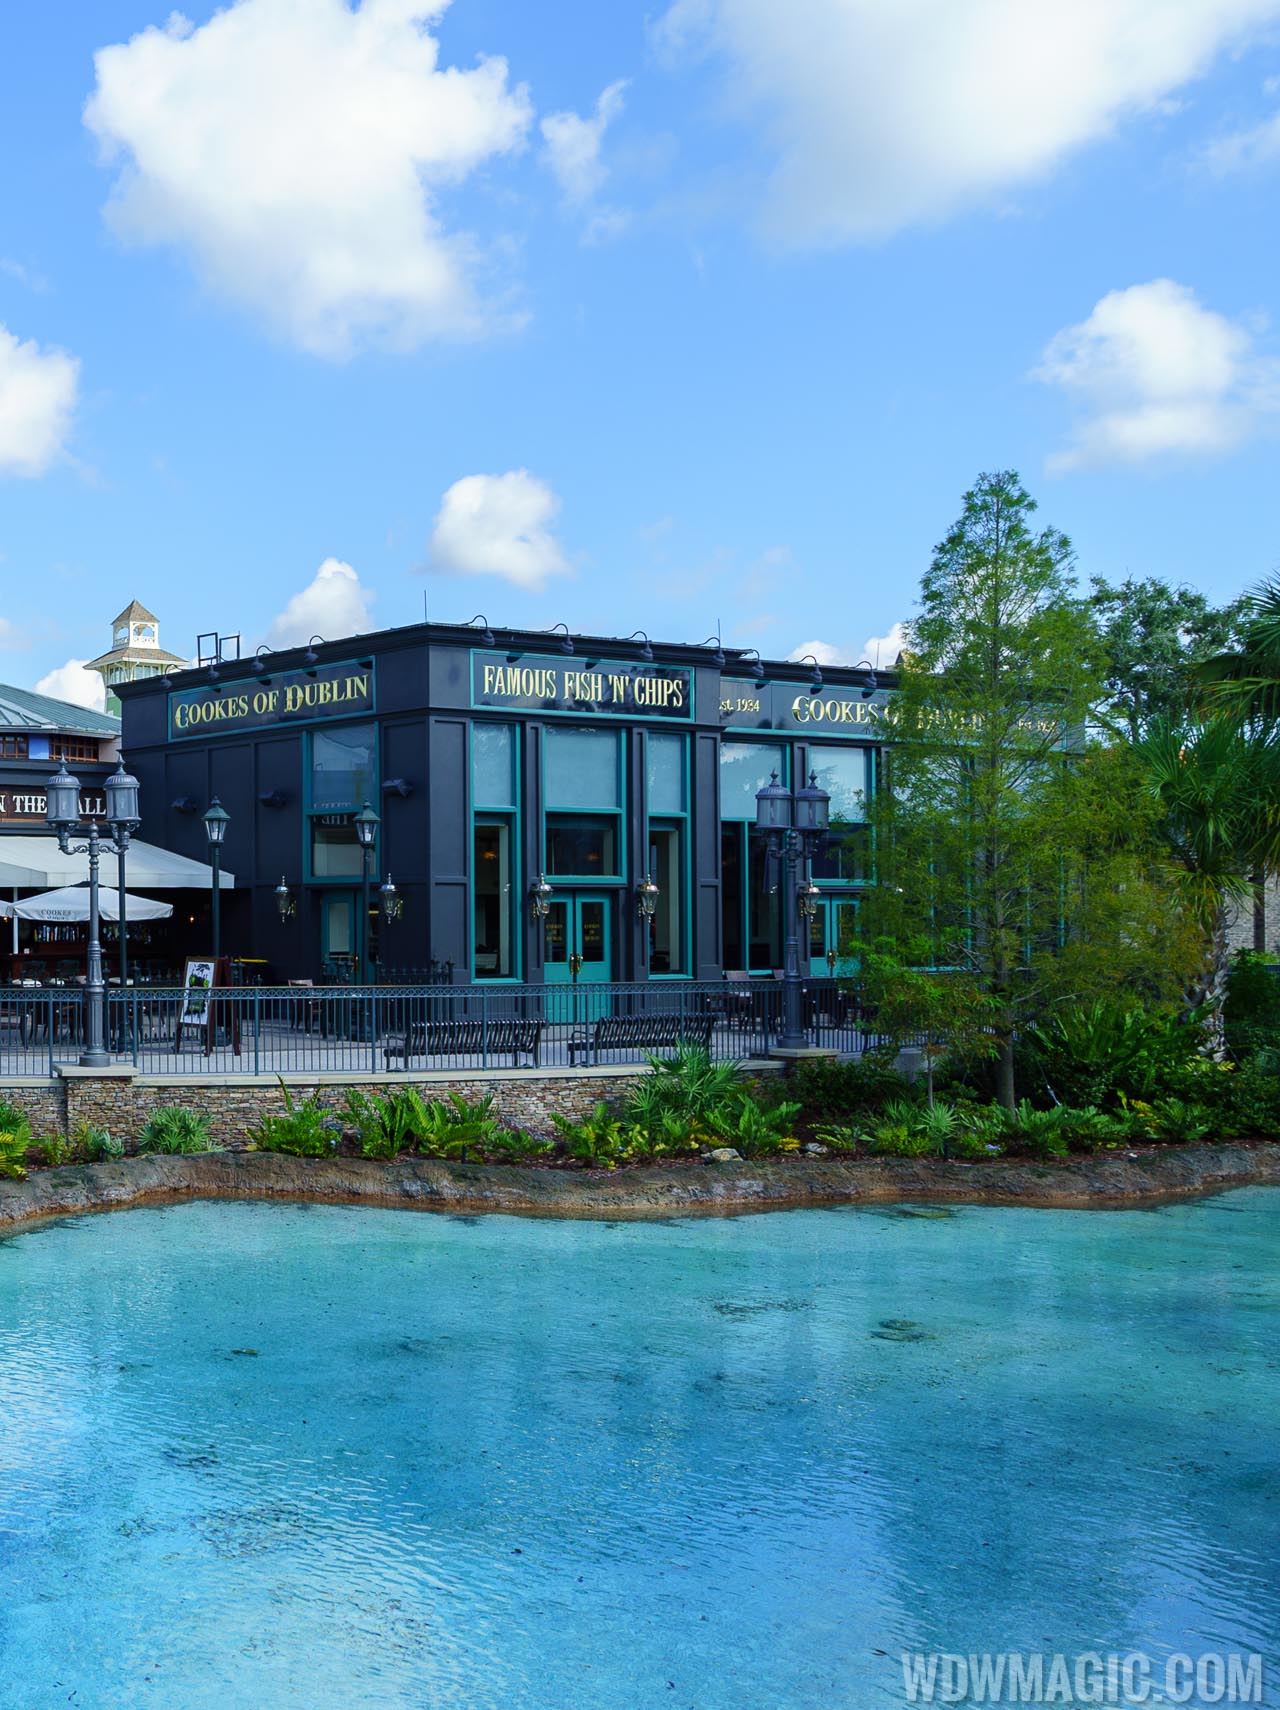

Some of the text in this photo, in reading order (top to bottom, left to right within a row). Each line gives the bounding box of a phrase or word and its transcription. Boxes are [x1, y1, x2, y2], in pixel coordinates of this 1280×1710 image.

[483, 665, 683, 707] FAMOUS FISH 'N' CHIPS
[175, 674, 369, 728] COOKES OF DUBLIN
[735, 698, 761, 712] 1934
[792, 695, 880, 724] COOKES
[12, 795, 48, 814] THE
[78, 797, 107, 816] ALL
